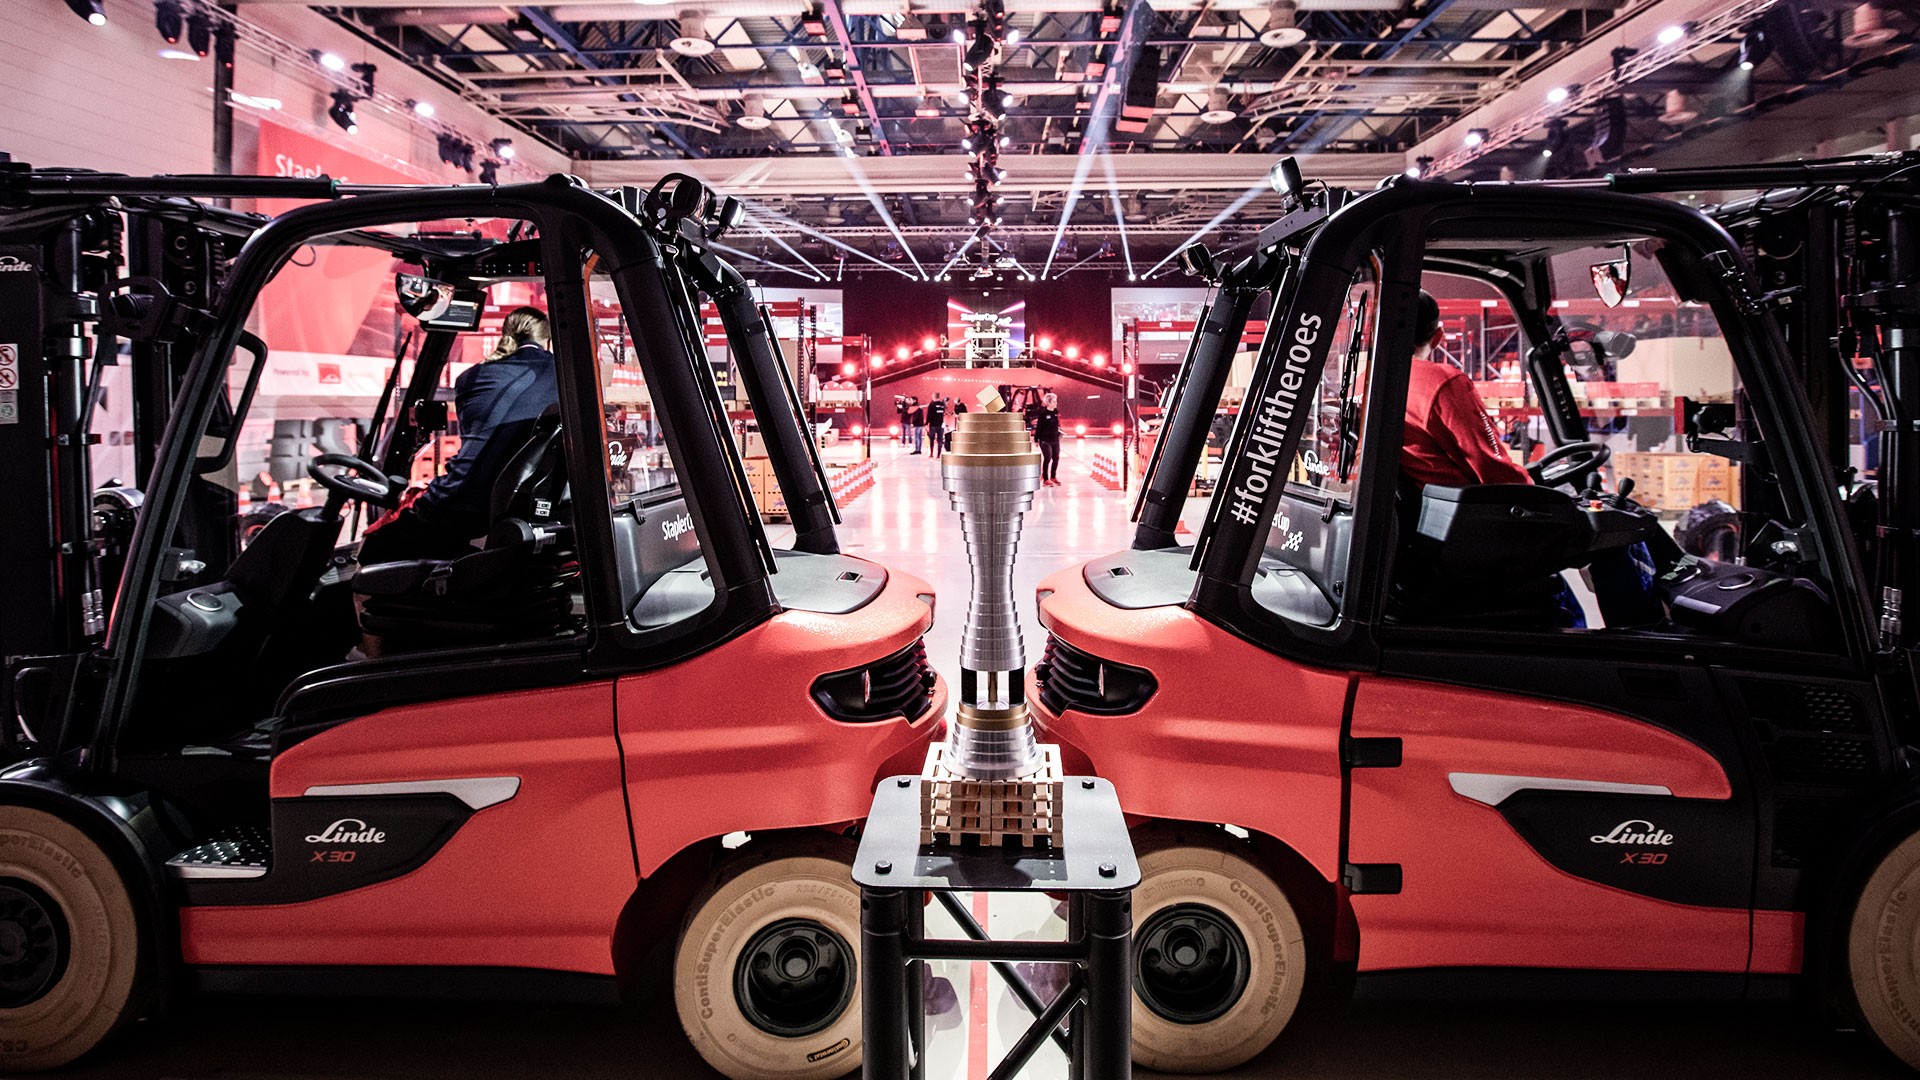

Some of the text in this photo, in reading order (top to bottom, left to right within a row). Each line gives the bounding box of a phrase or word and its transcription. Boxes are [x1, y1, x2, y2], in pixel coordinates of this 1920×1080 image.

[1231, 312, 1322, 525] #forkliftheroes
[1304, 450, 1330, 475] Linde
[305, 818, 386, 843] Linde
[1590, 819, 1674, 846] Linde
[696, 885, 777, 1020] ContiSuperElastic
[1230, 879, 1286, 1016] ContiSuperElastic
